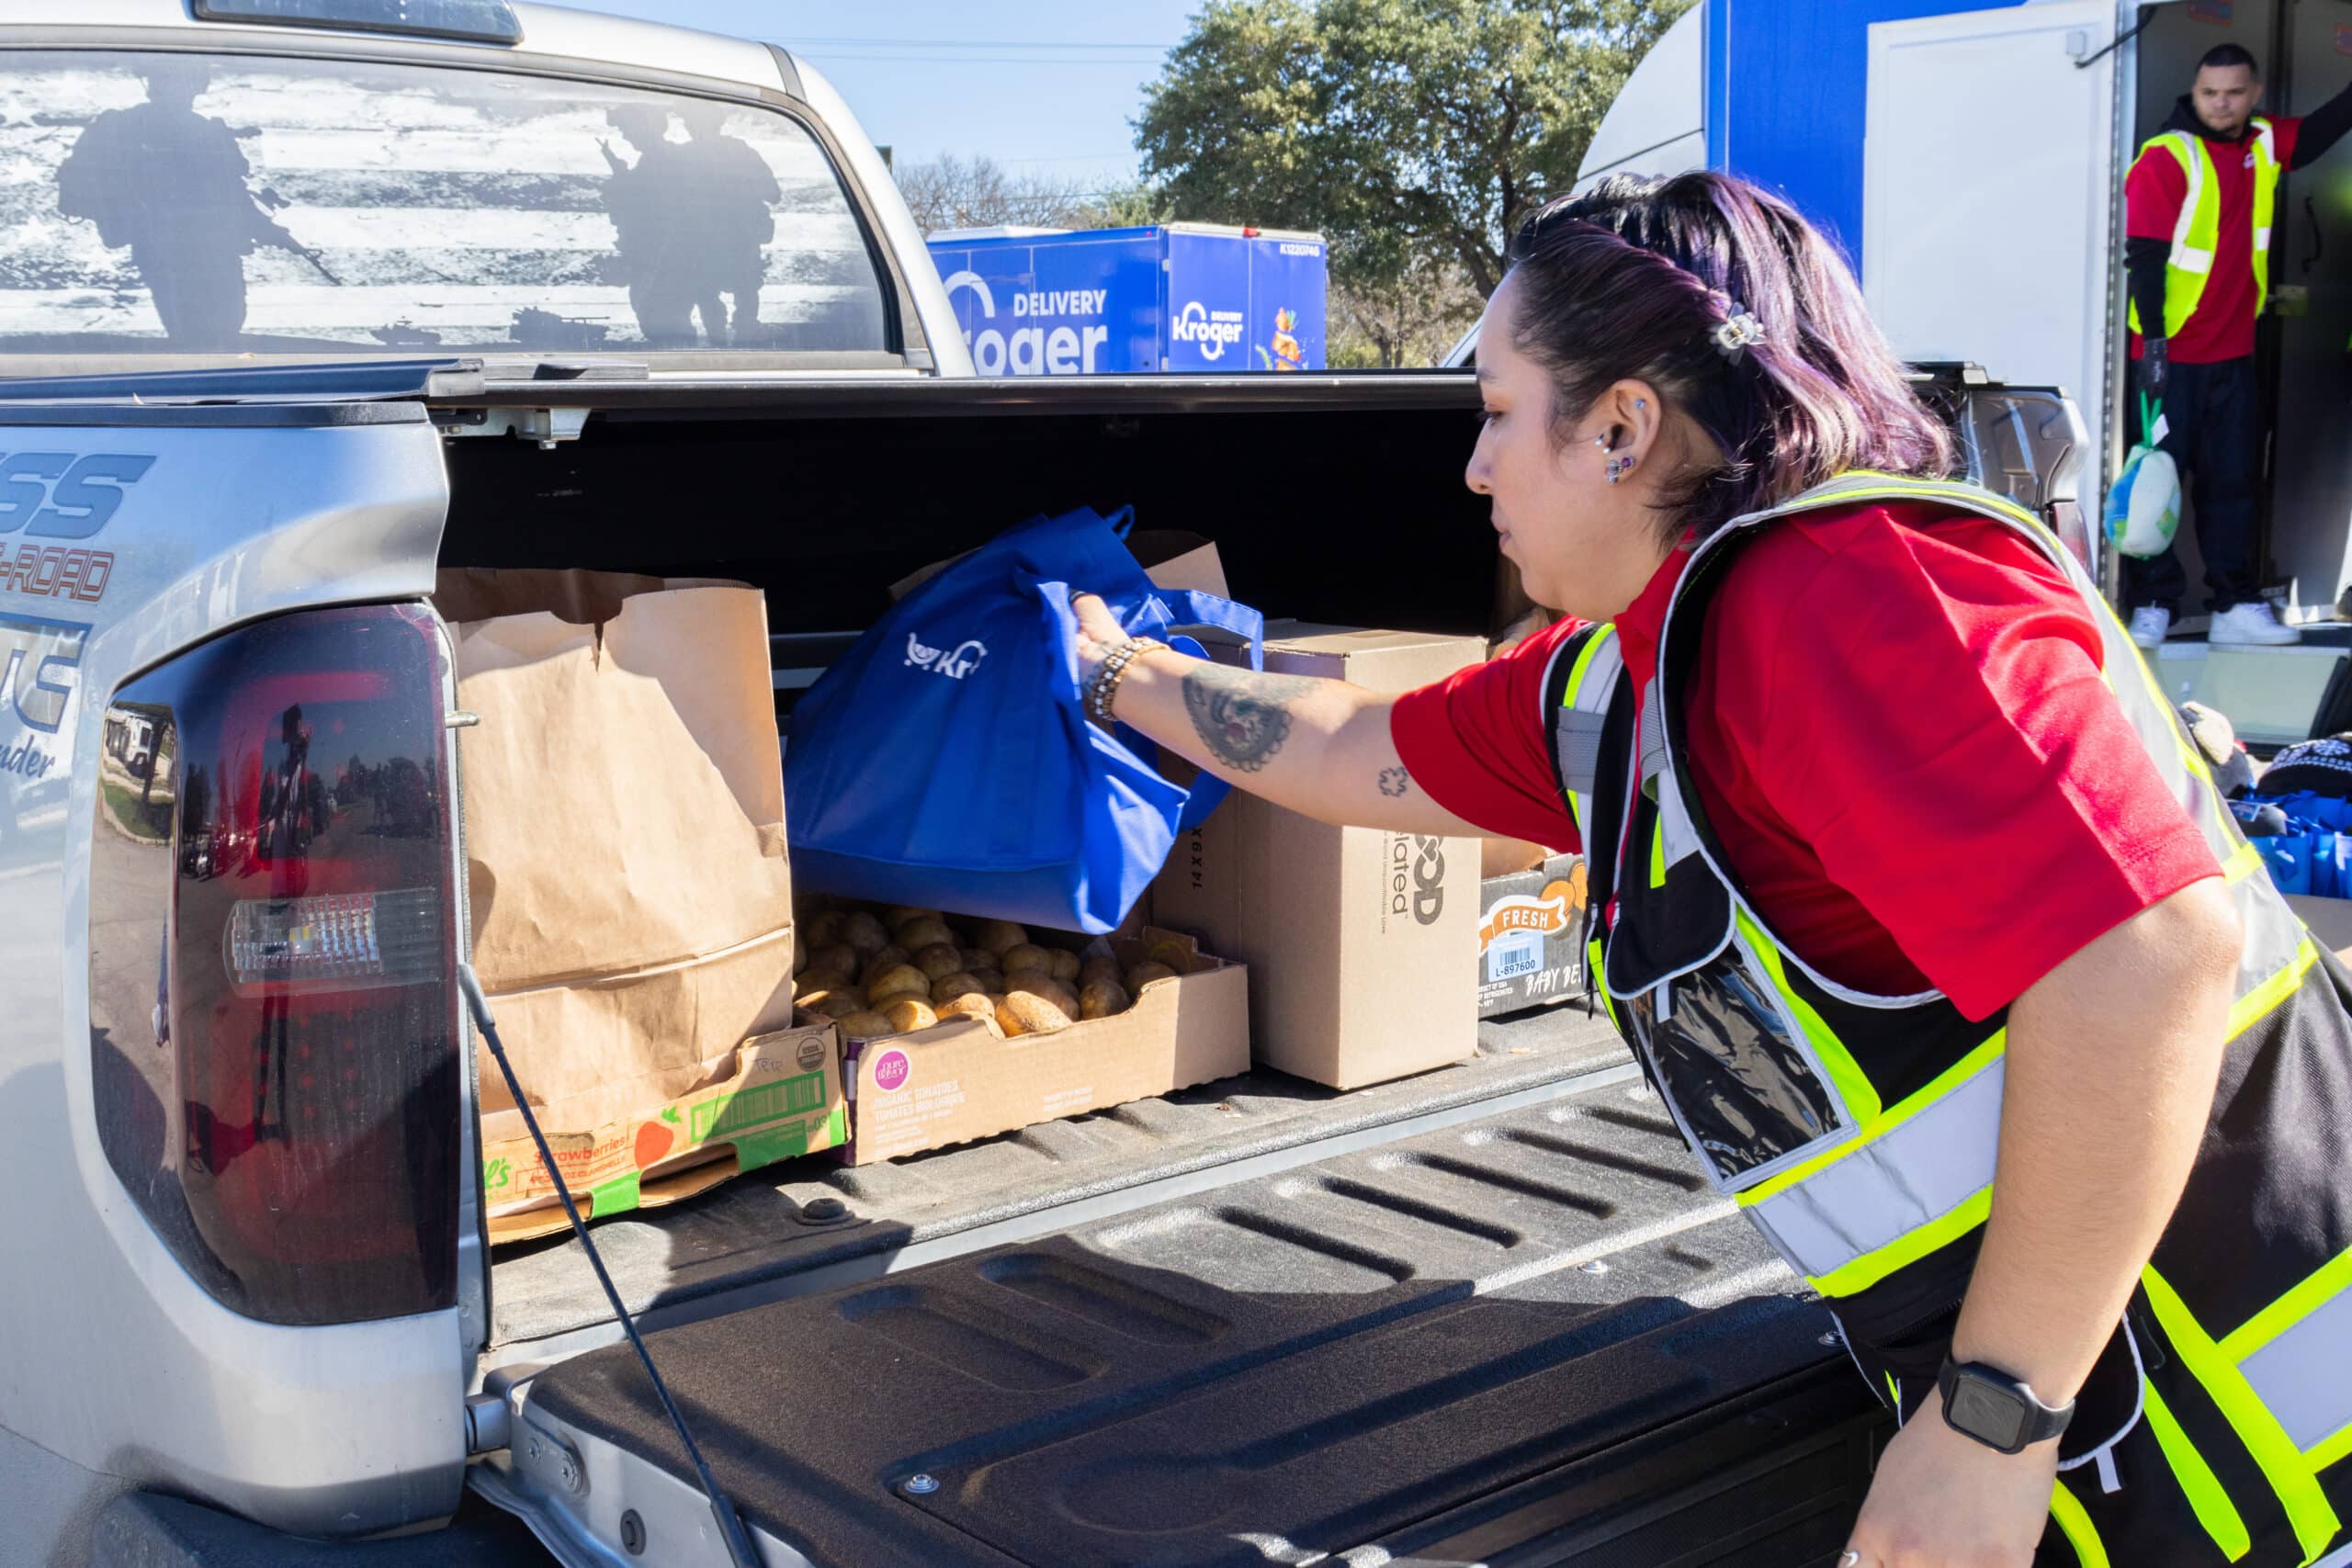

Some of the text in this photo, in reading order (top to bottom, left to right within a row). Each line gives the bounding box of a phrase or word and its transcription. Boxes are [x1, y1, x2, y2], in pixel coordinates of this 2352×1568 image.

[1013, 289, 1107, 317] DELIVERY
[1172, 301, 1243, 360] Kroger
[0, 542, 114, 602] -ROAD
[1392, 832, 1409, 915] lated
[1502, 909, 1548, 928] FRESH
[1496, 960, 1535, 976] L-897600
[1526, 964, 1581, 996] BABY BE
[535, 1137, 625, 1164] Srawberries
[483, 1156, 512, 1190] l's
